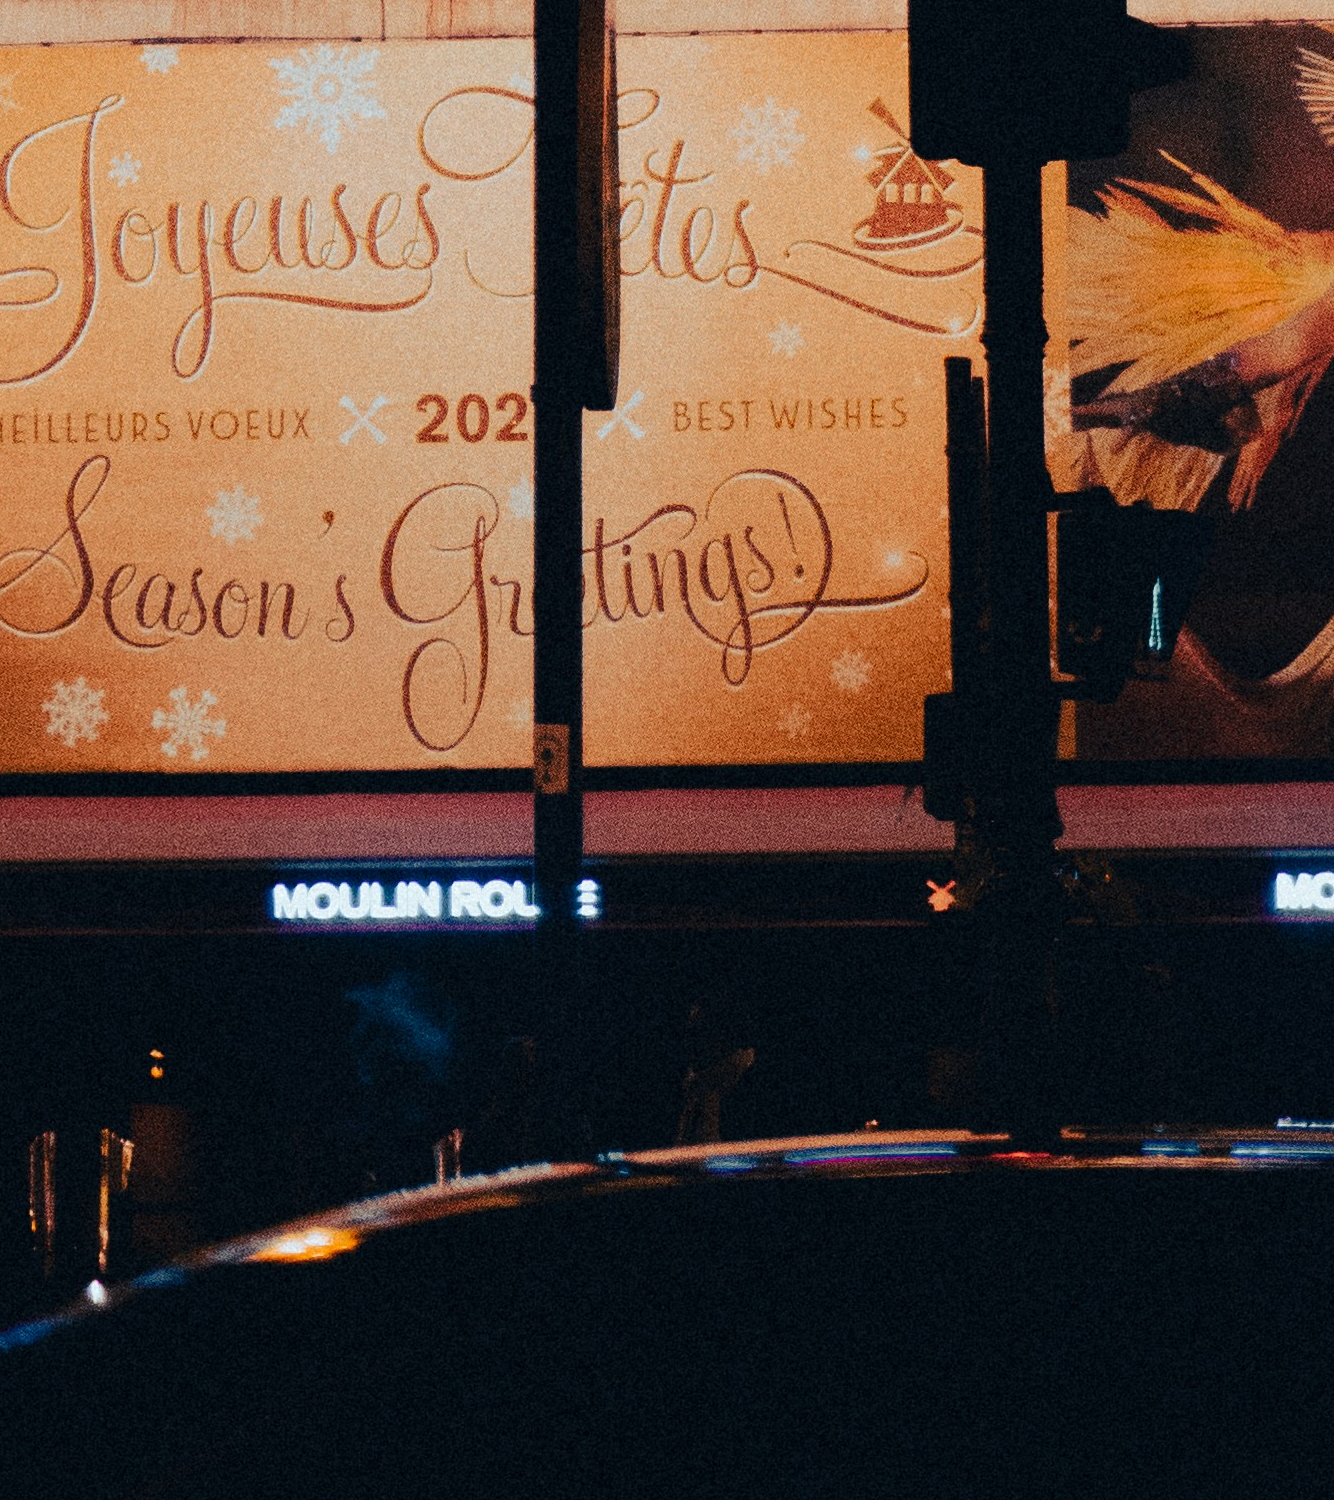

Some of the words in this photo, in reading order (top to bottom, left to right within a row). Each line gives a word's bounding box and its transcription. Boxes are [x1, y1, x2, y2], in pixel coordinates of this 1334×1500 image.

[187, 407, 311, 442] VOEUX
[672, 399, 754, 433] BEST
[766, 396, 909, 432] WISHES
[379, 468, 931, 752] Grtings!
[272, 880, 441, 919] MOULIN
